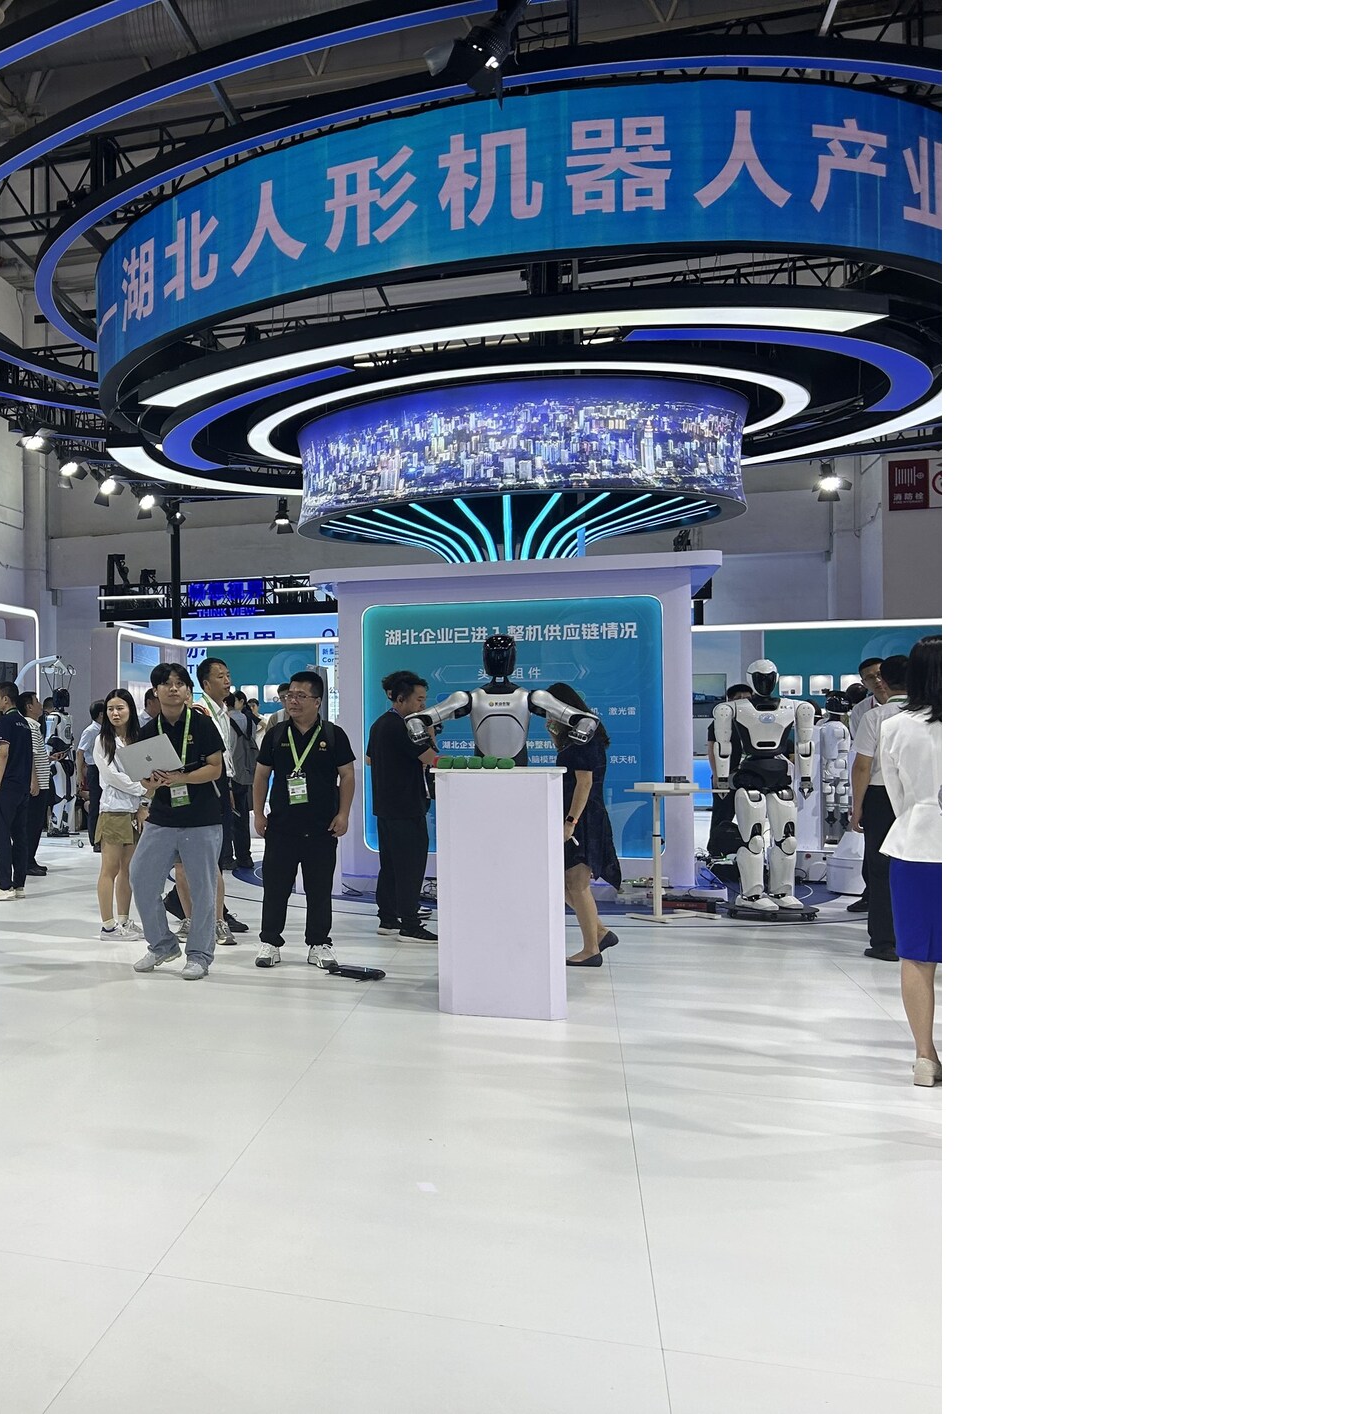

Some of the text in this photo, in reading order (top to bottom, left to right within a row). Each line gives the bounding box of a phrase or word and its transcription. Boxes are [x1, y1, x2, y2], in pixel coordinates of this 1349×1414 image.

[893, 492, 924, 500] 消防栓
[197, 607, 256, 617] THINK VIEW
[477, 667, 541, 679] 头组件
[442, 741, 475, 749] 湖北企业
[610, 755, 637, 764] 京天机
